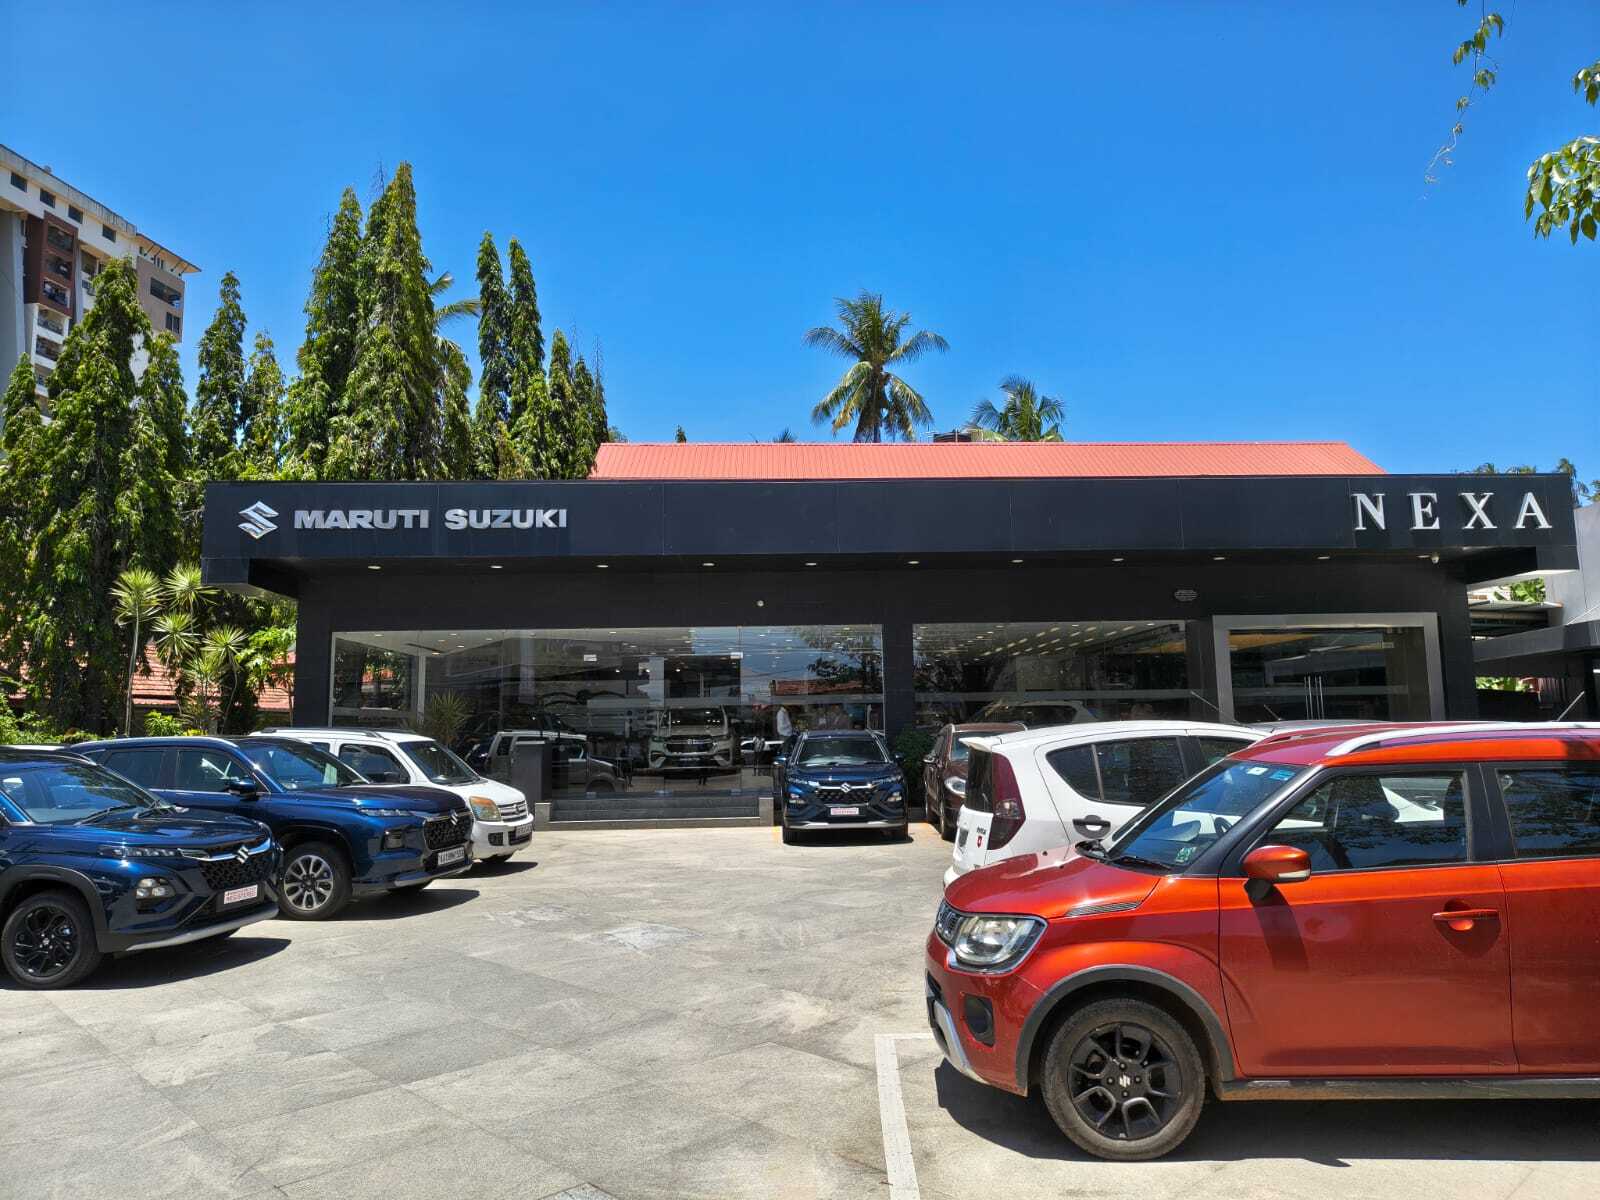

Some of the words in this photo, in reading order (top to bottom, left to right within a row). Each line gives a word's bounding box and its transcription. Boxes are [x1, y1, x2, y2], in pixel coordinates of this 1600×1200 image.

[294, 509, 429, 529] MARUTI
[444, 508, 567, 530] SUZUKI
[1352, 492, 1552, 530] NEXA
